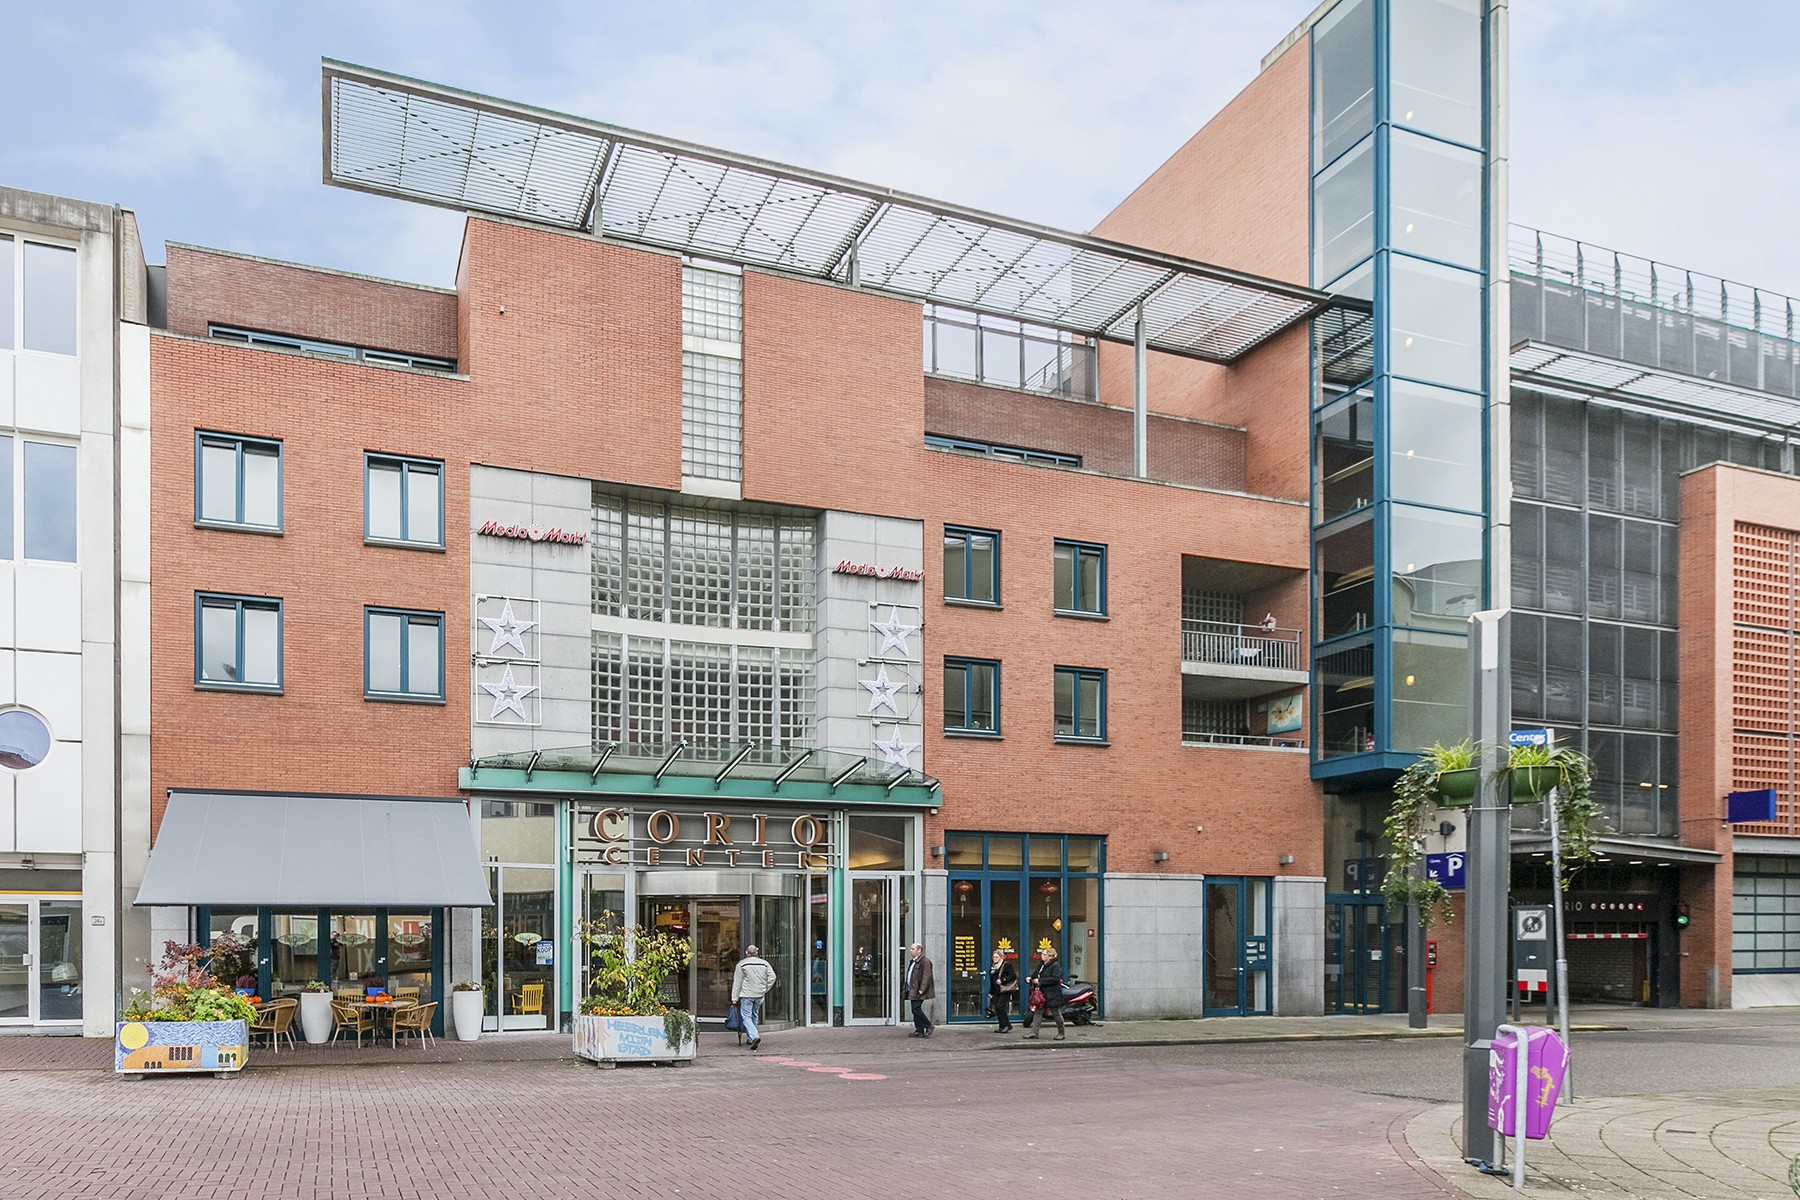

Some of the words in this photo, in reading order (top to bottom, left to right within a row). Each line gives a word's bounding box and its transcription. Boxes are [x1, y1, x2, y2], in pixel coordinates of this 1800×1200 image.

[478, 520, 528, 538] Media
[542, 527, 587, 546] Markt
[833, 559, 876, 577] Media
[593, 807, 824, 848] CORIO
[604, 845, 814, 868] CENTER
[1448, 857, 1463, 877] P
